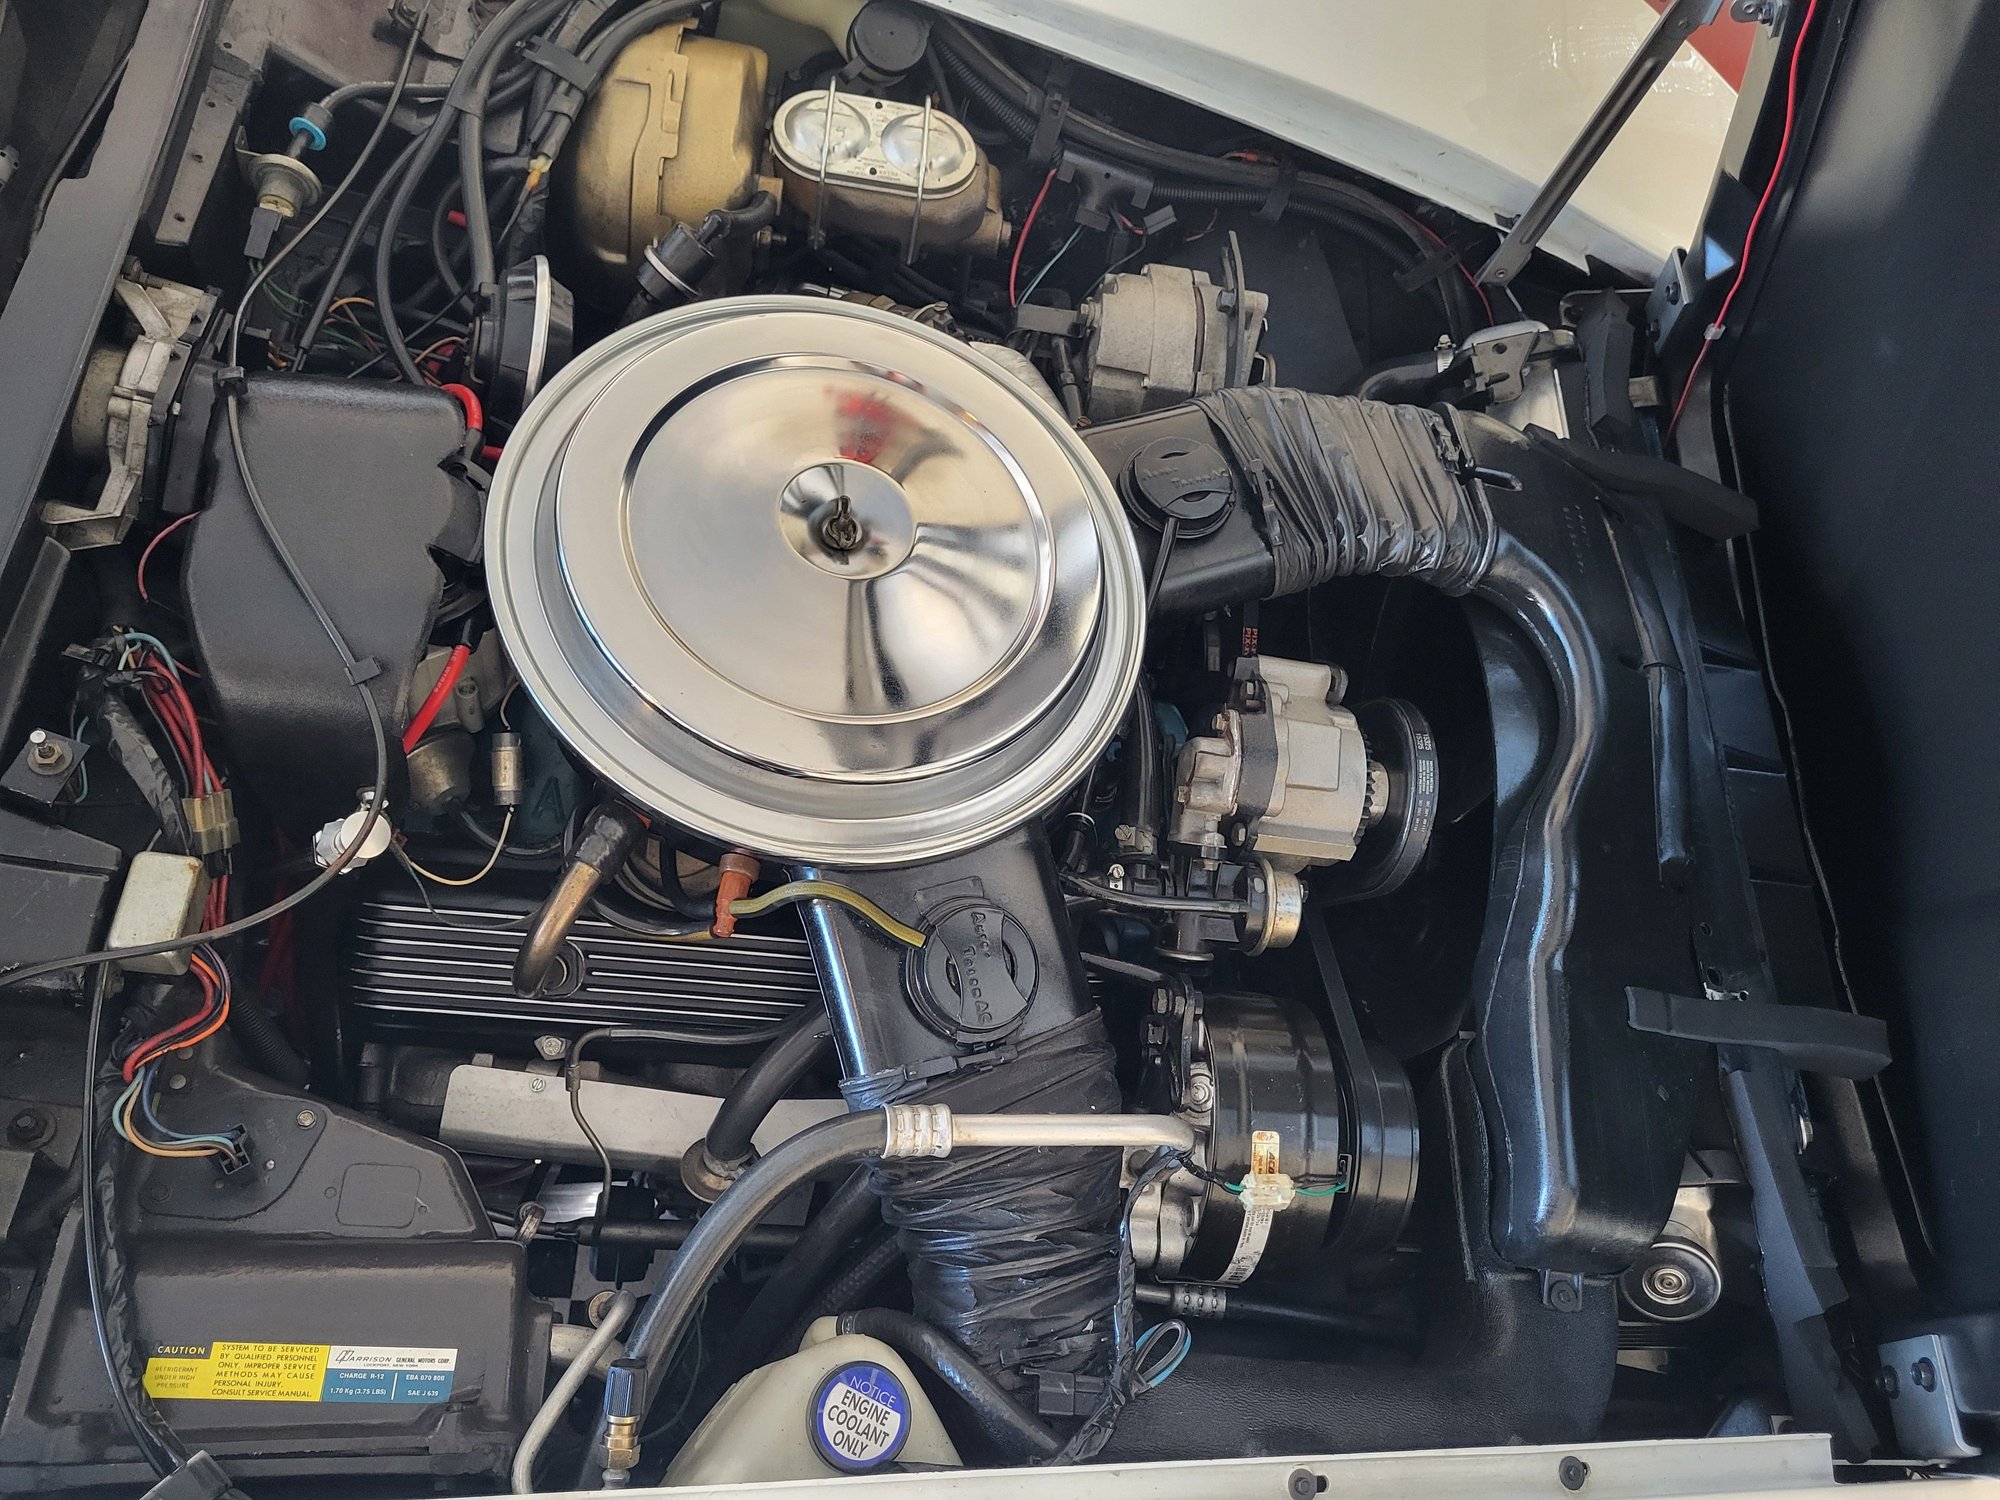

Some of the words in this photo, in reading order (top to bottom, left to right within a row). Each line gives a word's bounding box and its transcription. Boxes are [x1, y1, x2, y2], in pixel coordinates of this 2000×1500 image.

[158, 1346, 205, 1354] CAUTION
[841, 1390, 890, 1426] ENGINE
[850, 1376, 896, 1408] NOTICE
[828, 1405, 890, 1447] COOLANT
[833, 1430, 868, 1458] ONLY
